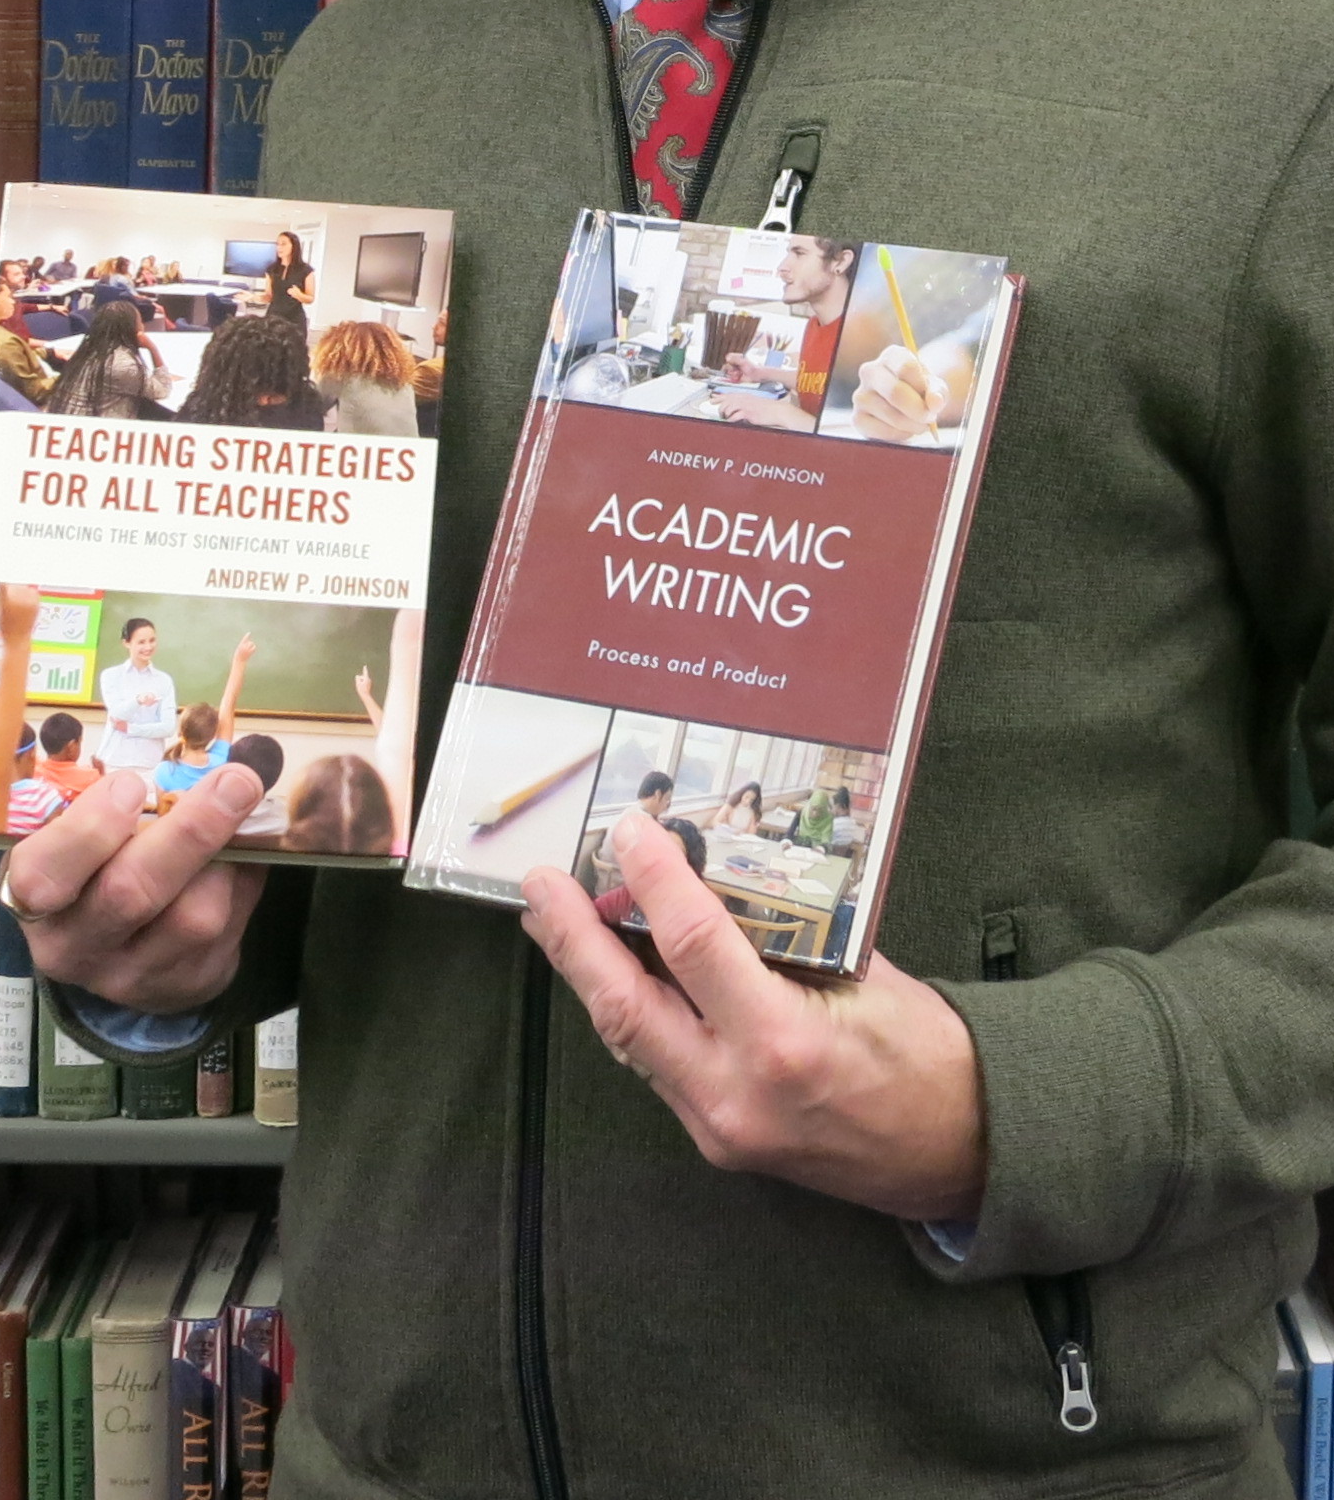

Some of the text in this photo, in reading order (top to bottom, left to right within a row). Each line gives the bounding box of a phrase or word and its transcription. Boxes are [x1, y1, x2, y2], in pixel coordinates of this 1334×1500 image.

[137, 43, 204, 81] Doctors
[164, 39, 185, 48] THE
[141, 82, 199, 126] Mayo
[27, 424, 417, 482] TEACHING STRATEGIES
[647, 448, 825, 486] ANDREW P. JOHNSON
[20, 471, 352, 525] FOR ALL TEACHERS
[13, 522, 371, 560] ENHANCING THE MOST SIGNIFICANT VARIABLE
[588, 493, 852, 571] ACADEMIC
[205, 568, 411, 600] ANDREW P. JOHNSON
[603, 556, 811, 629] WRITING
[587, 639, 788, 691] Process and Product
